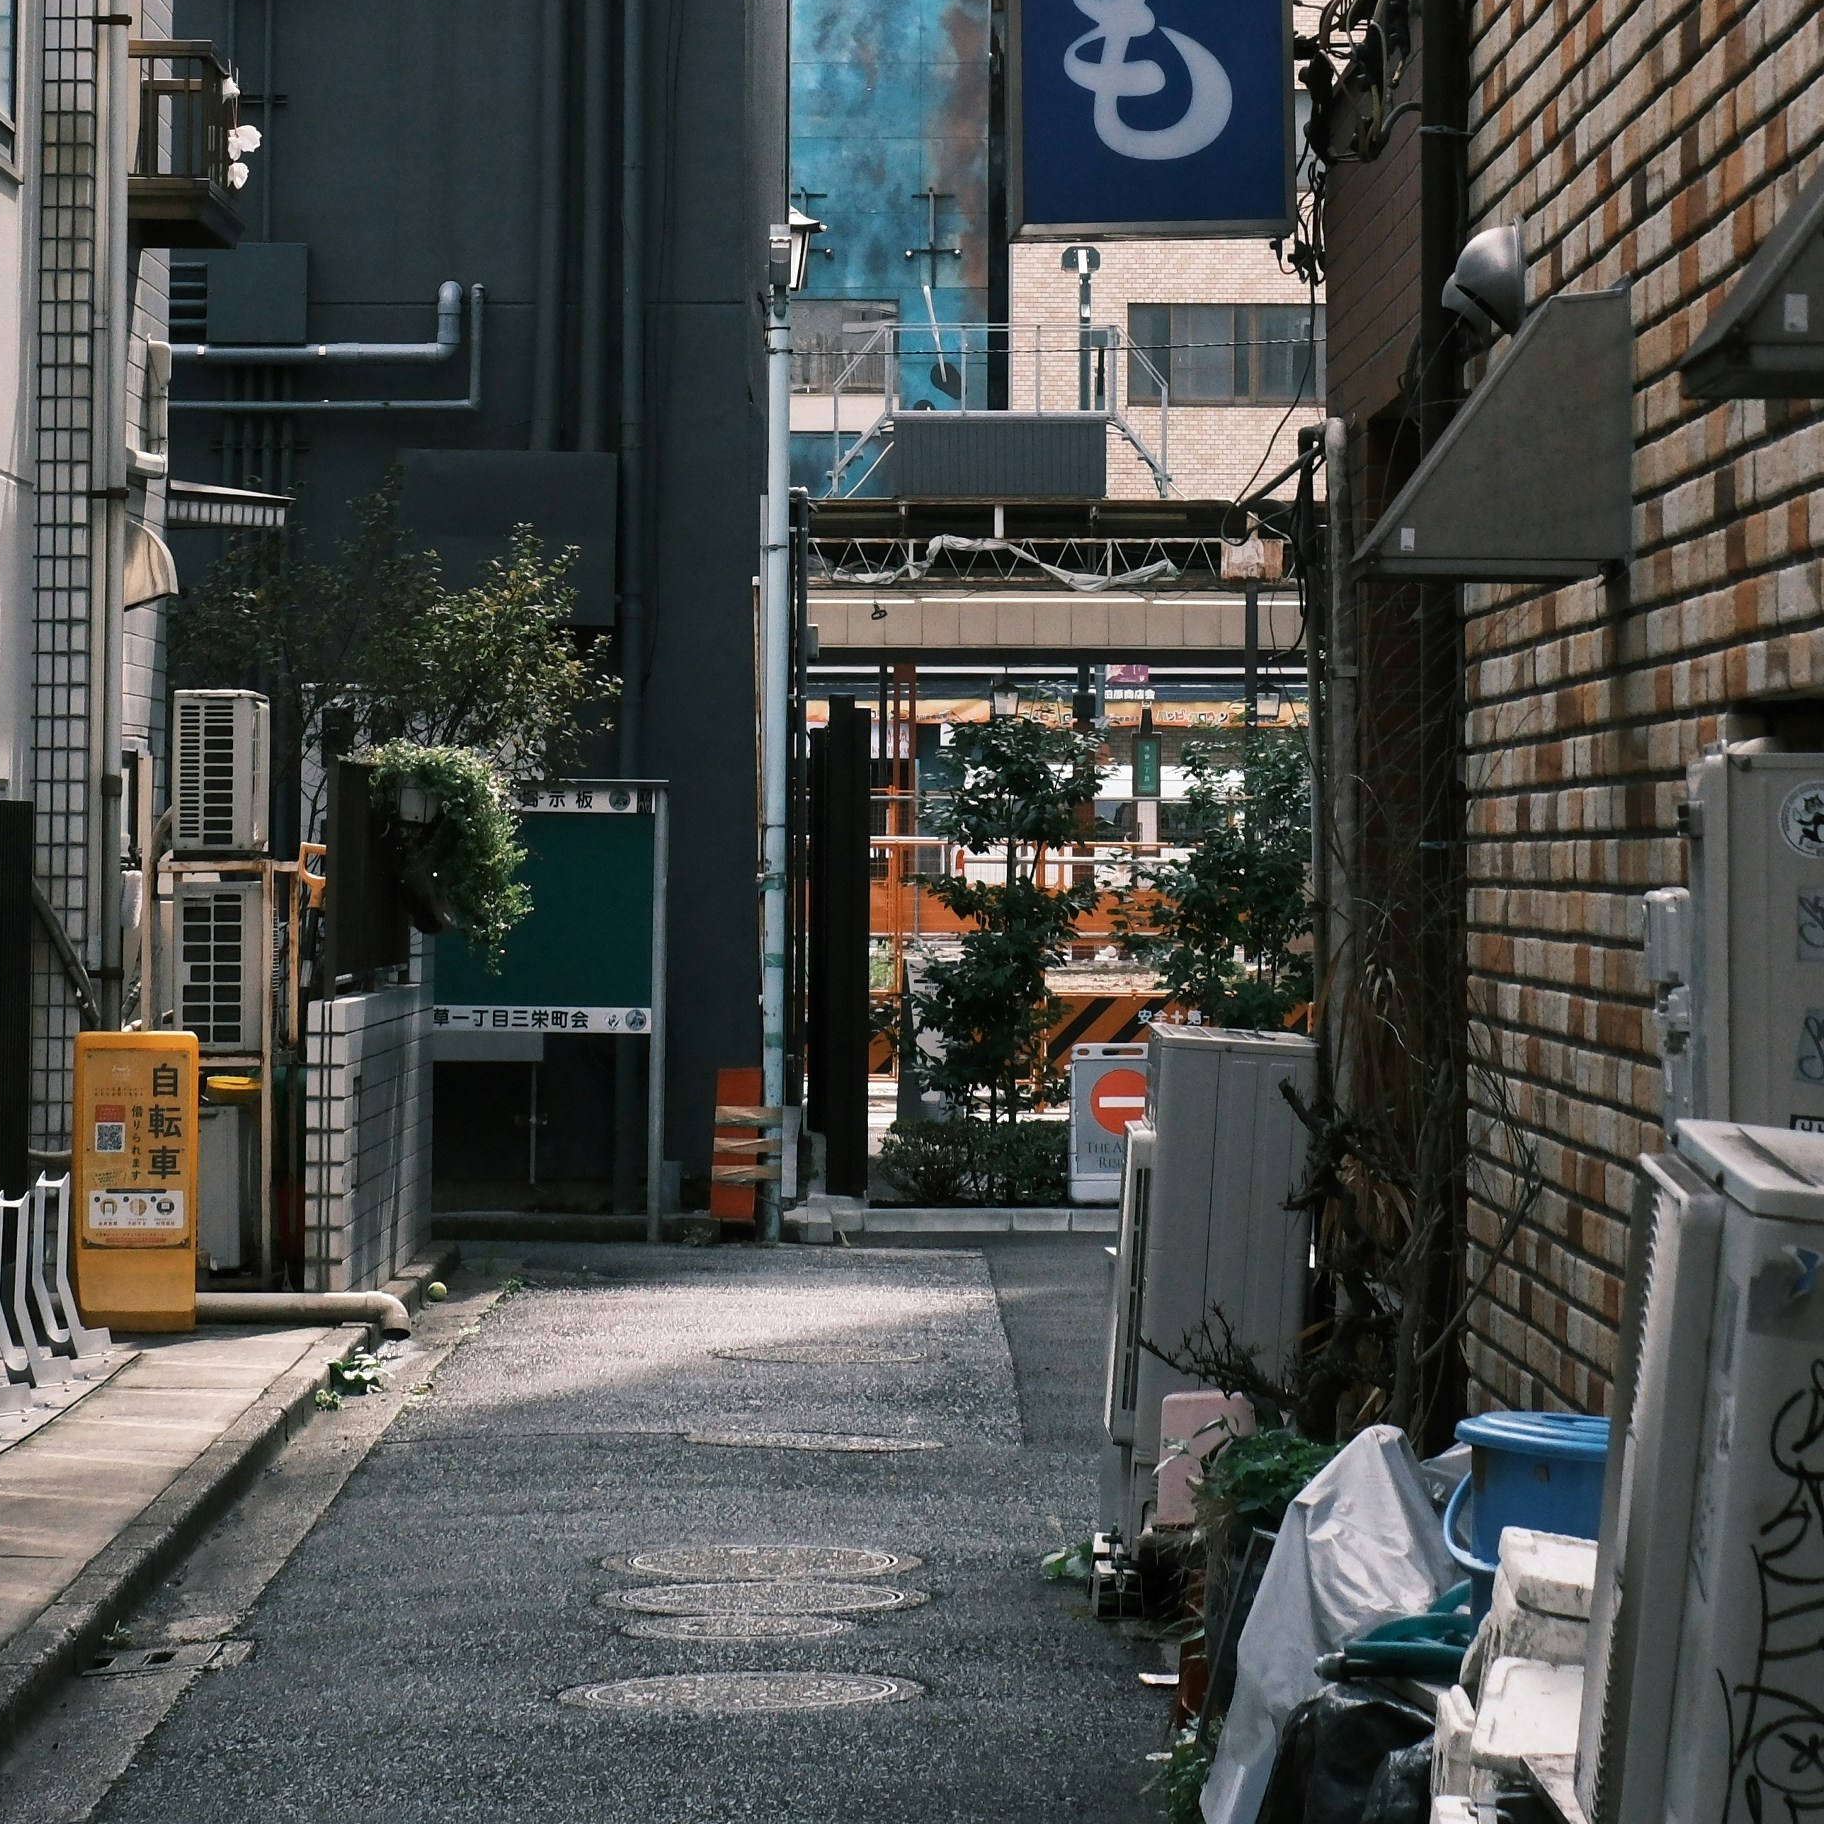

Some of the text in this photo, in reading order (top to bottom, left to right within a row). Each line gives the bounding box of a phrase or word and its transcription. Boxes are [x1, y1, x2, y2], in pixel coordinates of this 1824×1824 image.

[147, 1062, 182, 1180] 自転車
[1087, 1141, 1110, 1154] THE
[1099, 1156, 1122, 1169] RESI
